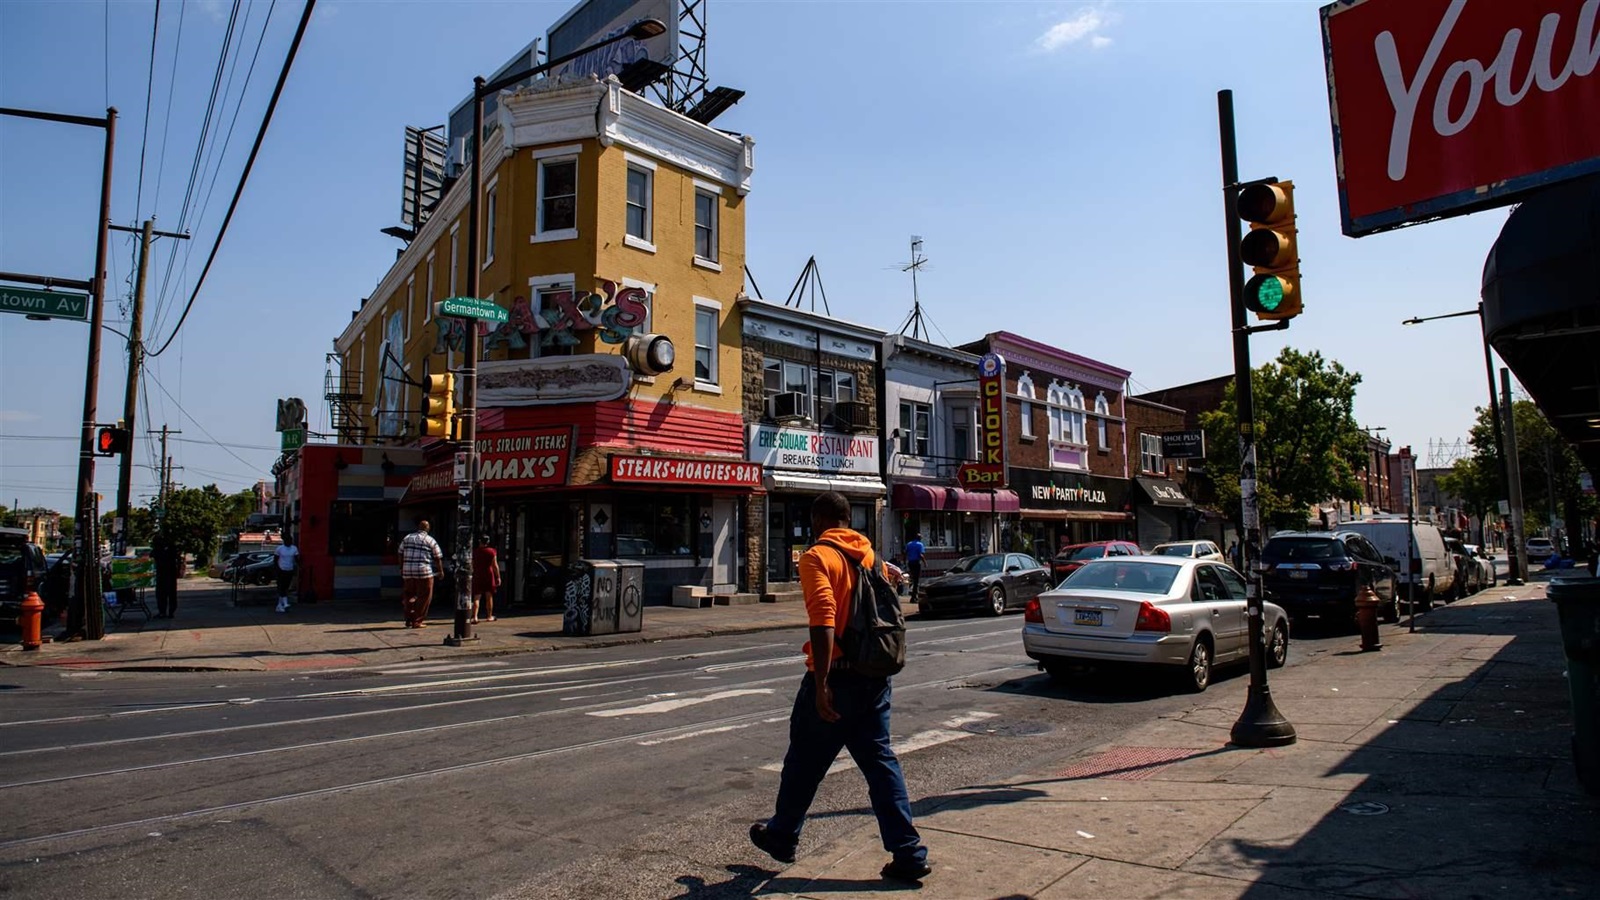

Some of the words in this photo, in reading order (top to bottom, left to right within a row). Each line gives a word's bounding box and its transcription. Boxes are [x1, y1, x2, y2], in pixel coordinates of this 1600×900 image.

[0, 292, 46, 309] town
[56, 297, 81, 312] Av
[444, 300, 495, 319] Germantown
[497, 309, 508, 321] Av
[985, 381, 1001, 463] CLOCK
[475, 438, 493, 454] 00%
[496, 436, 532, 453] SIRLOIN
[534, 435, 567, 450] STEAKS
[759, 430, 777, 448] ERIE
[778, 432, 808, 452] SQUARE
[811, 435, 874, 459] RESTAURANT
[1163, 434, 1182, 442] SHOE
[1183, 433, 1202, 441] PLUS
[479, 456, 558, 481] MAX'S
[617, 458, 671, 479] STEAKS
[675, 462, 731, 482] HOAGIES
[736, 465, 759, 483] BAR
[782, 453, 825, 468] BREAKFAST
[831, 457, 855, 469] LUNCH
[965, 468, 1003, 483] Bar
[1032, 484, 1051, 500] NEW
[1056, 486, 1078, 502] PARTY
[1083, 489, 1107, 503] PLAZA
[597, 576, 613, 594] NO
